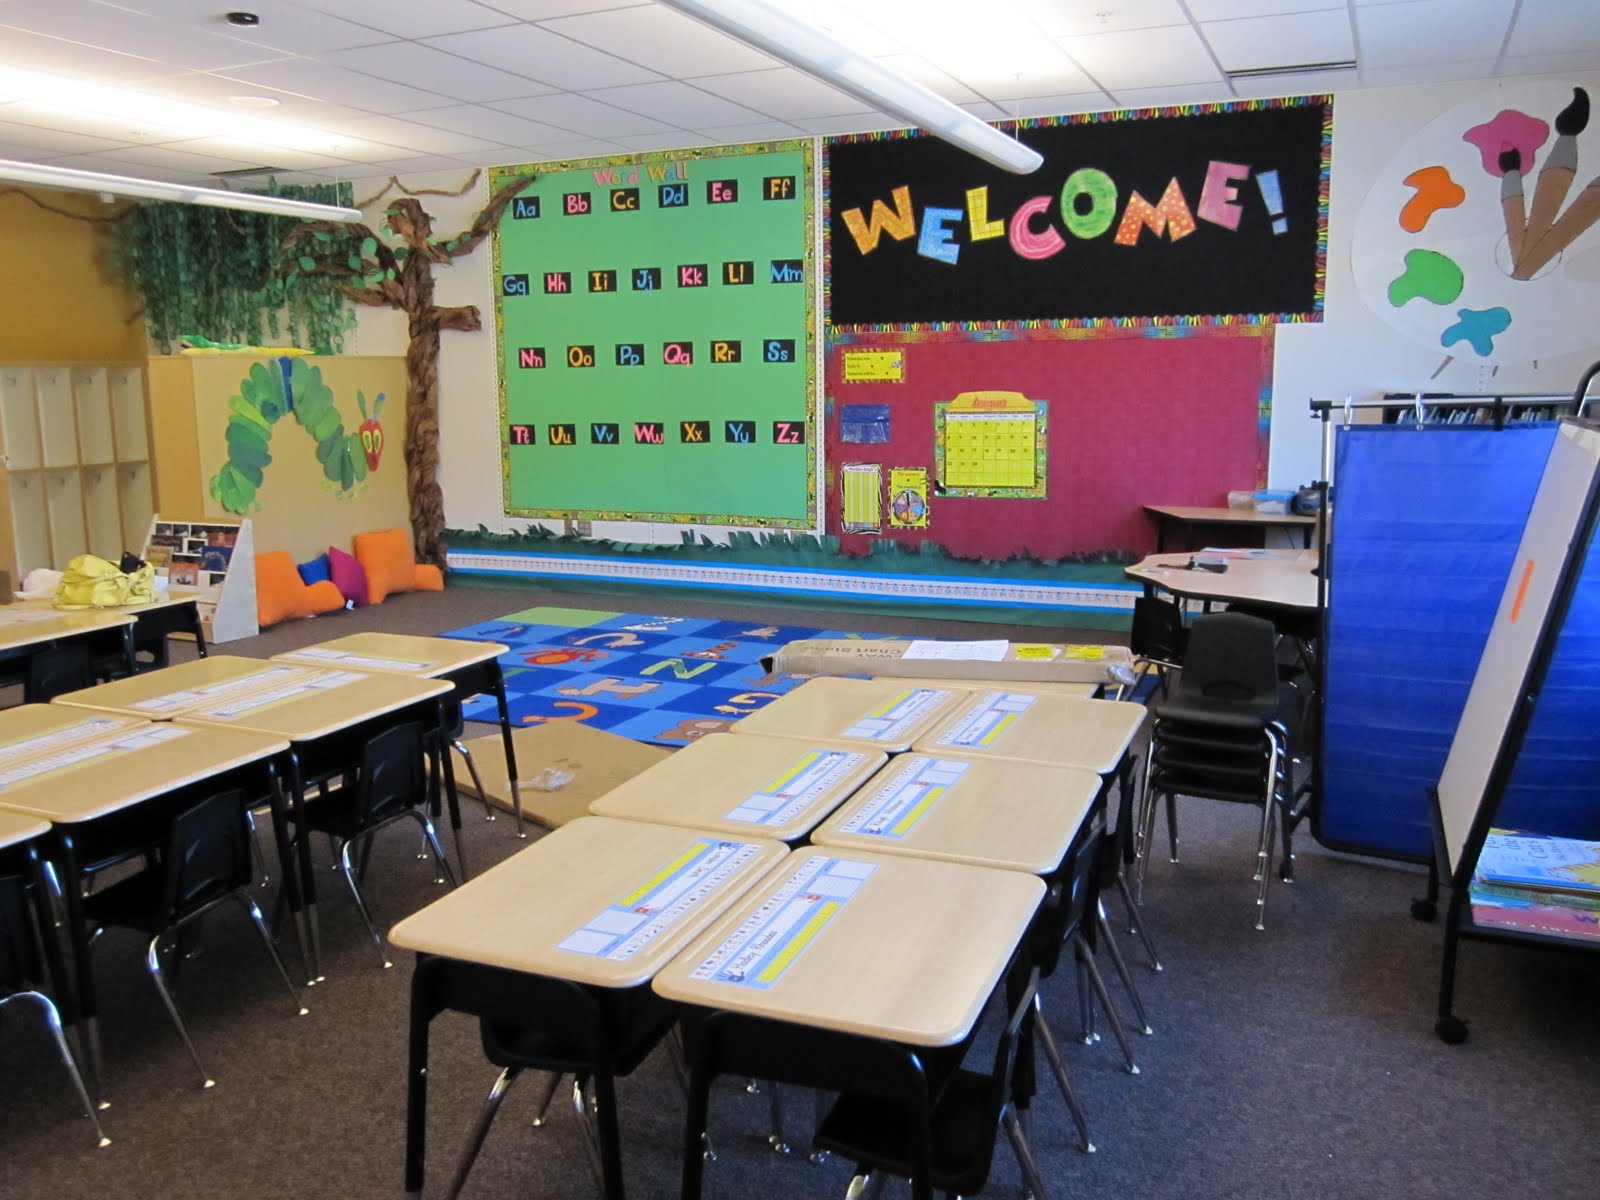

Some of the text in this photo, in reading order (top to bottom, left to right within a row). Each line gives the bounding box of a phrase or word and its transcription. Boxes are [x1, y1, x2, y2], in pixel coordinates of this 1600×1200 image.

[592, 161, 689, 186] Word Wall
[517, 178, 791, 217] Aa Bb Cc Dd Ee Ff
[501, 263, 803, 297] Gg Hh Ii Jj Kk Ll Mm
[520, 340, 789, 368] Nn Oo Pp Qq Rr Ss
[512, 422, 800, 445] Tt Uu Vv Ww Xx Yy Zz
